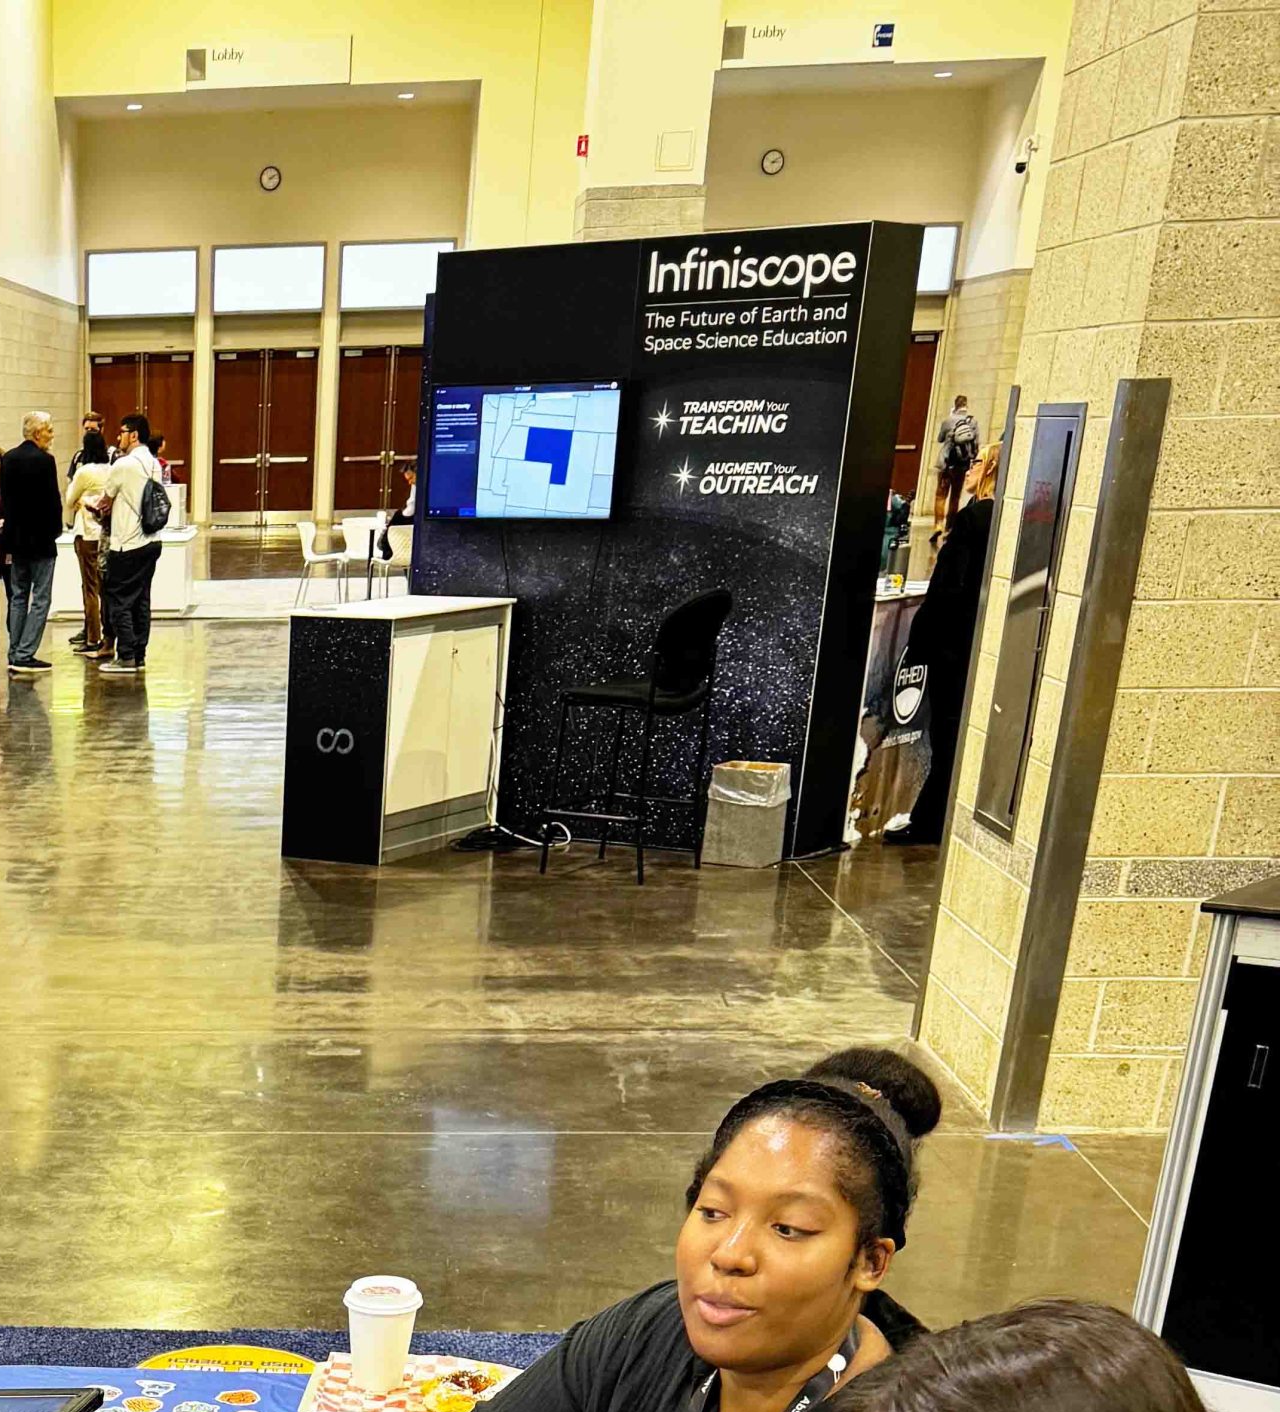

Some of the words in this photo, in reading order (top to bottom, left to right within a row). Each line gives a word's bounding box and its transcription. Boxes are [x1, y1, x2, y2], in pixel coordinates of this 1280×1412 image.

[752, 25, 787, 41] Lobby
[212, 48, 244, 64] Lobby
[648, 245, 856, 299] Infiniscope
[645, 312, 675, 329] The
[680, 309, 735, 327] Future
[740, 306, 758, 324] of
[762, 305, 808, 323] Earth
[813, 303, 847, 321] and
[644, 333, 692, 355] Space
[697, 331, 758, 349] Science
[762, 327, 847, 346] Education
[682, 399, 765, 414] TRANSFORM
[766, 400, 789, 413] Your
[679, 414, 788, 436] TEACHING
[704, 462, 772, 475] AUGMENT
[773, 462, 797, 475] Your
[699, 474, 818, 496] OUTREACH
[898, 665, 924, 686] AHED
[261, 1360, 304, 1368] NASA
